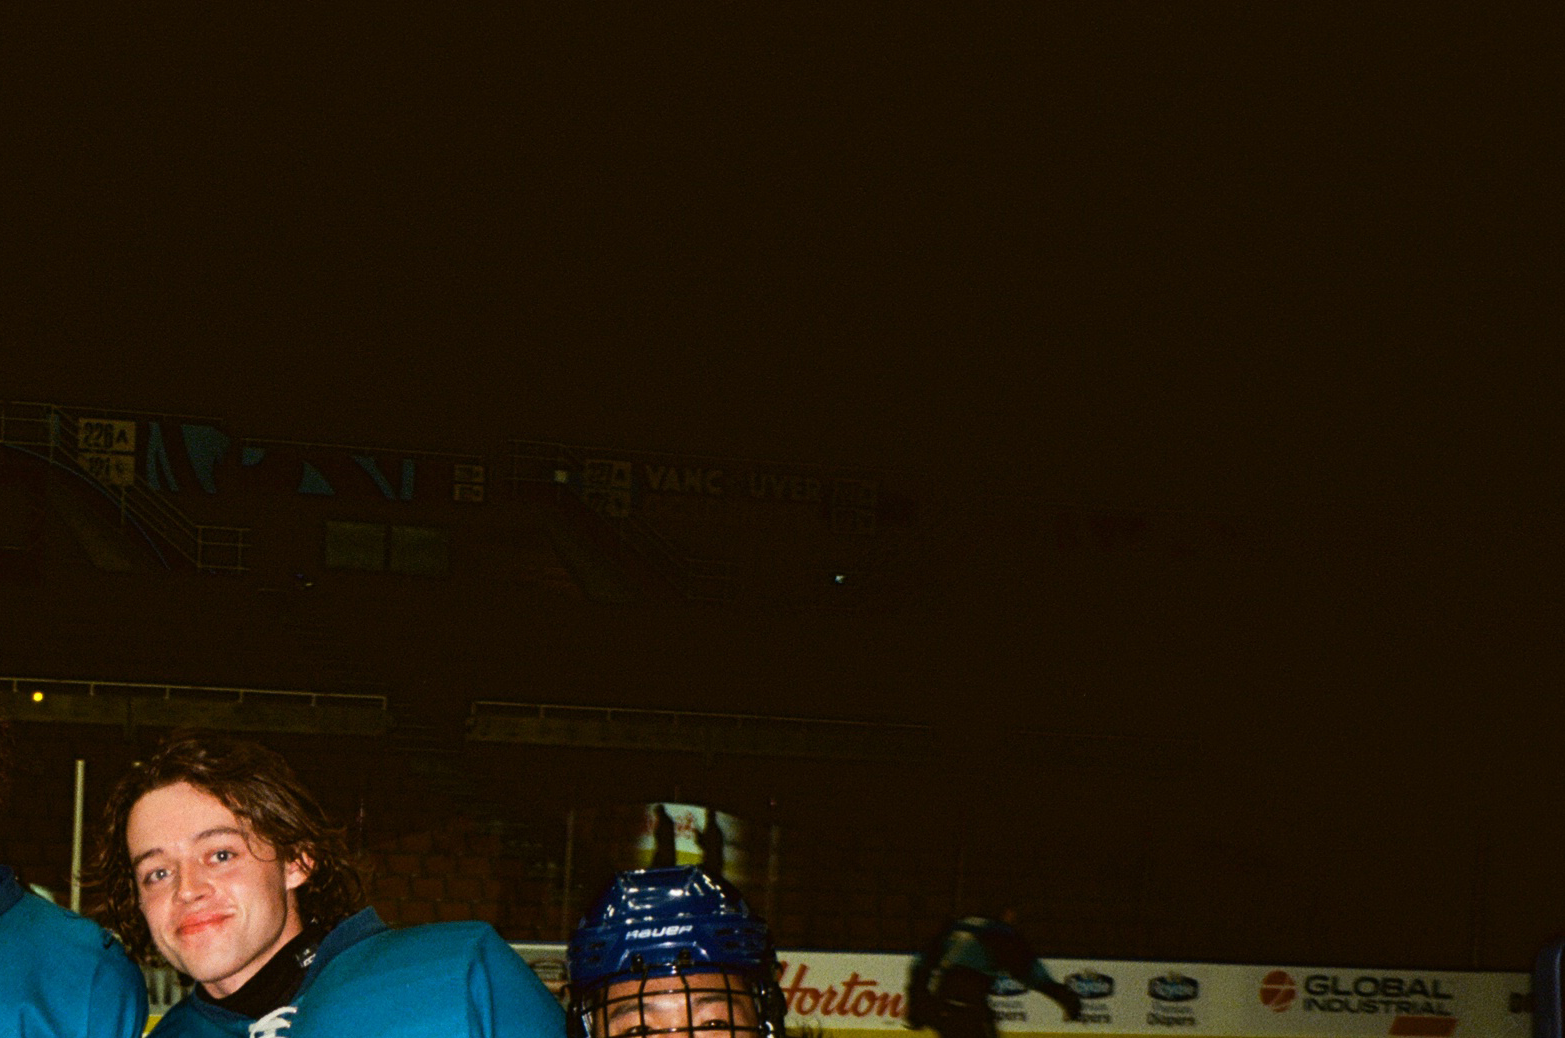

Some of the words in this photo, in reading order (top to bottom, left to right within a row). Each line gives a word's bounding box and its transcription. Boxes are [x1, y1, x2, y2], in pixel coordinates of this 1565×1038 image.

[645, 463, 823, 502] VANCUVER
[1304, 974, 1453, 1000] GLOBAL
[1303, 998, 1452, 1016] INDUSTRIAL
